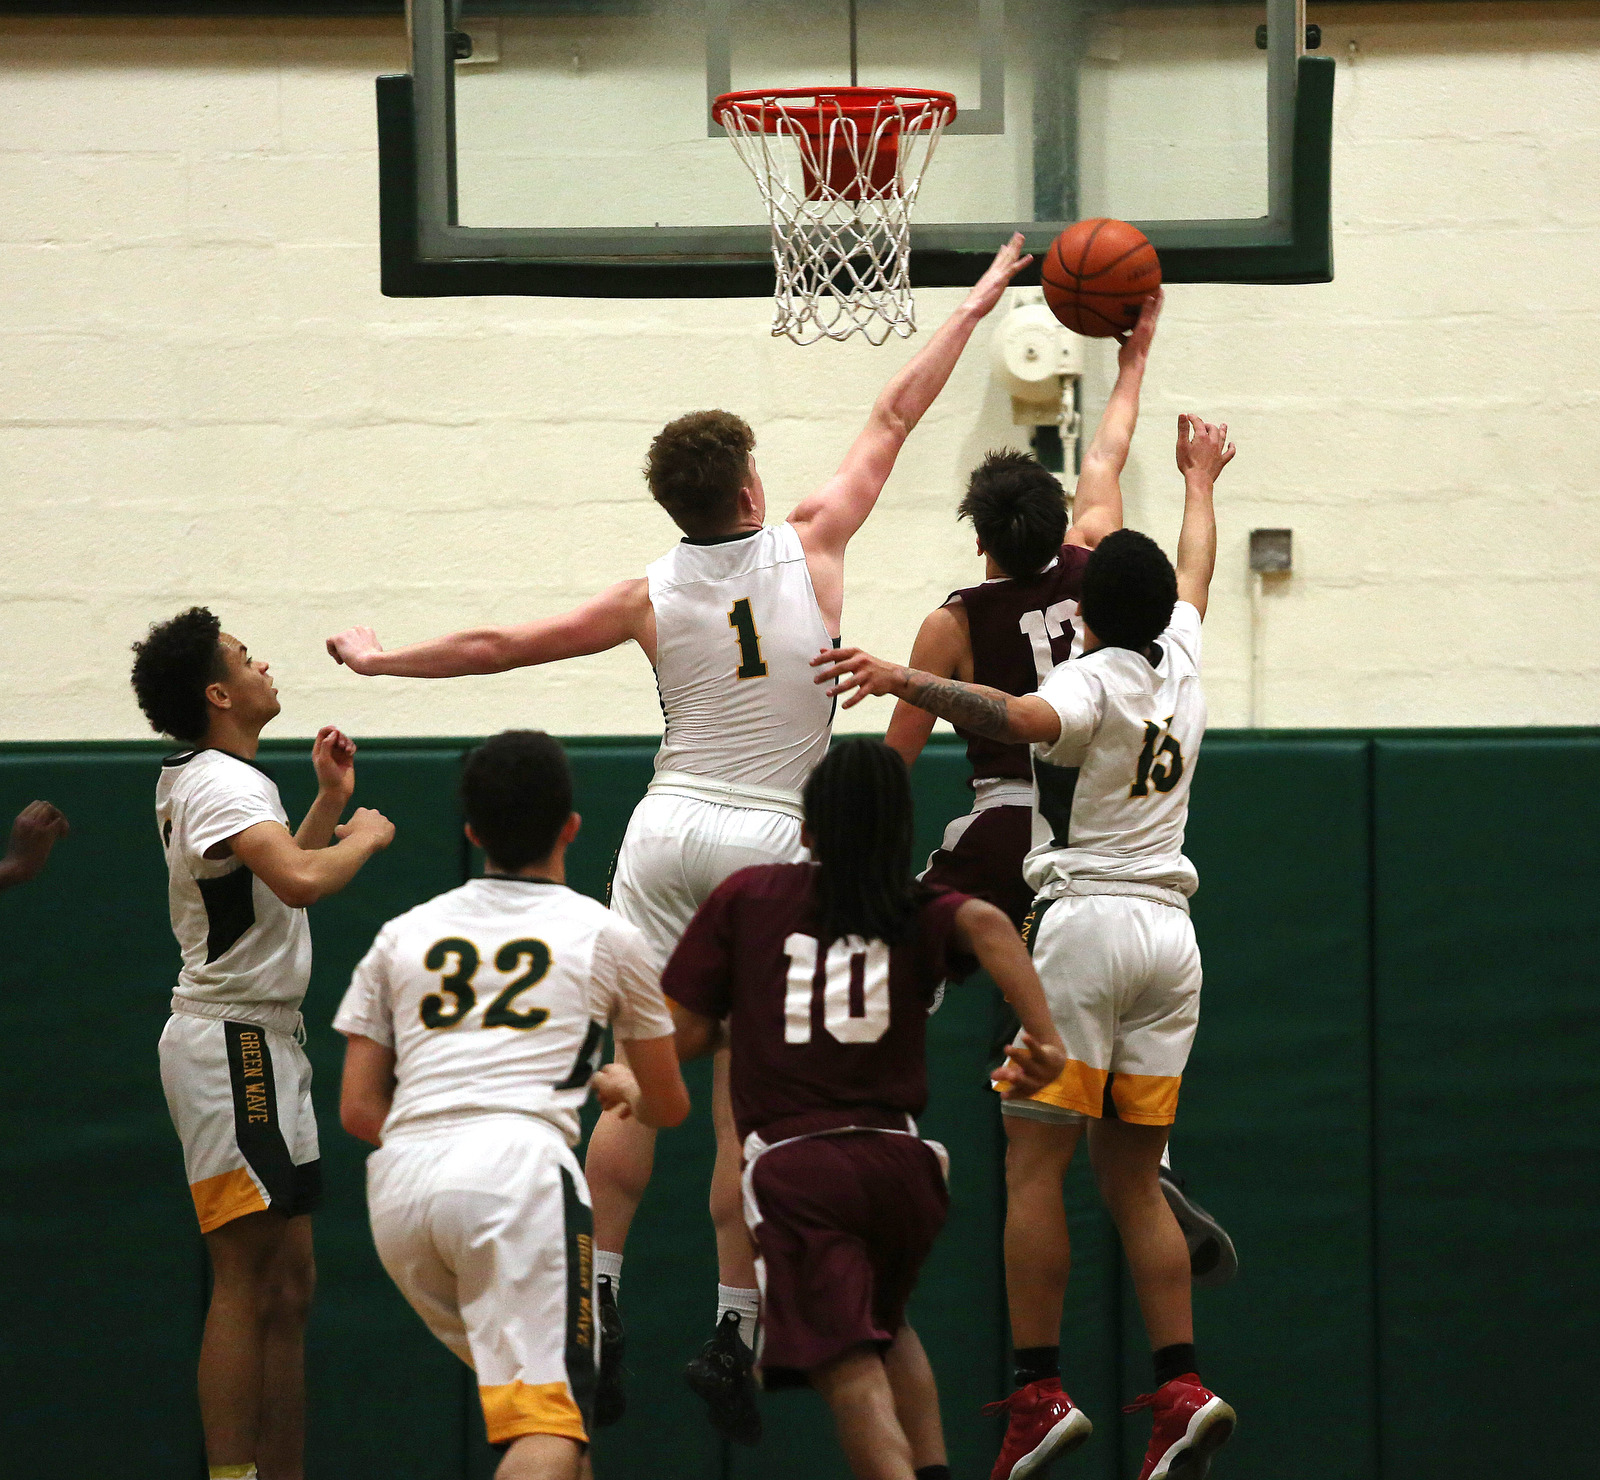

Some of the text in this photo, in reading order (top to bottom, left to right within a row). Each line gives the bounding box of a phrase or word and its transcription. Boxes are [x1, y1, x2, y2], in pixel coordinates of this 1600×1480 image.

[727, 596, 769, 681] 1
[1129, 714, 1184, 799] 15
[419, 936, 555, 1032] 32
[783, 931, 892, 1044] 10
[239, 1031, 269, 1124] GREEN WAVE
